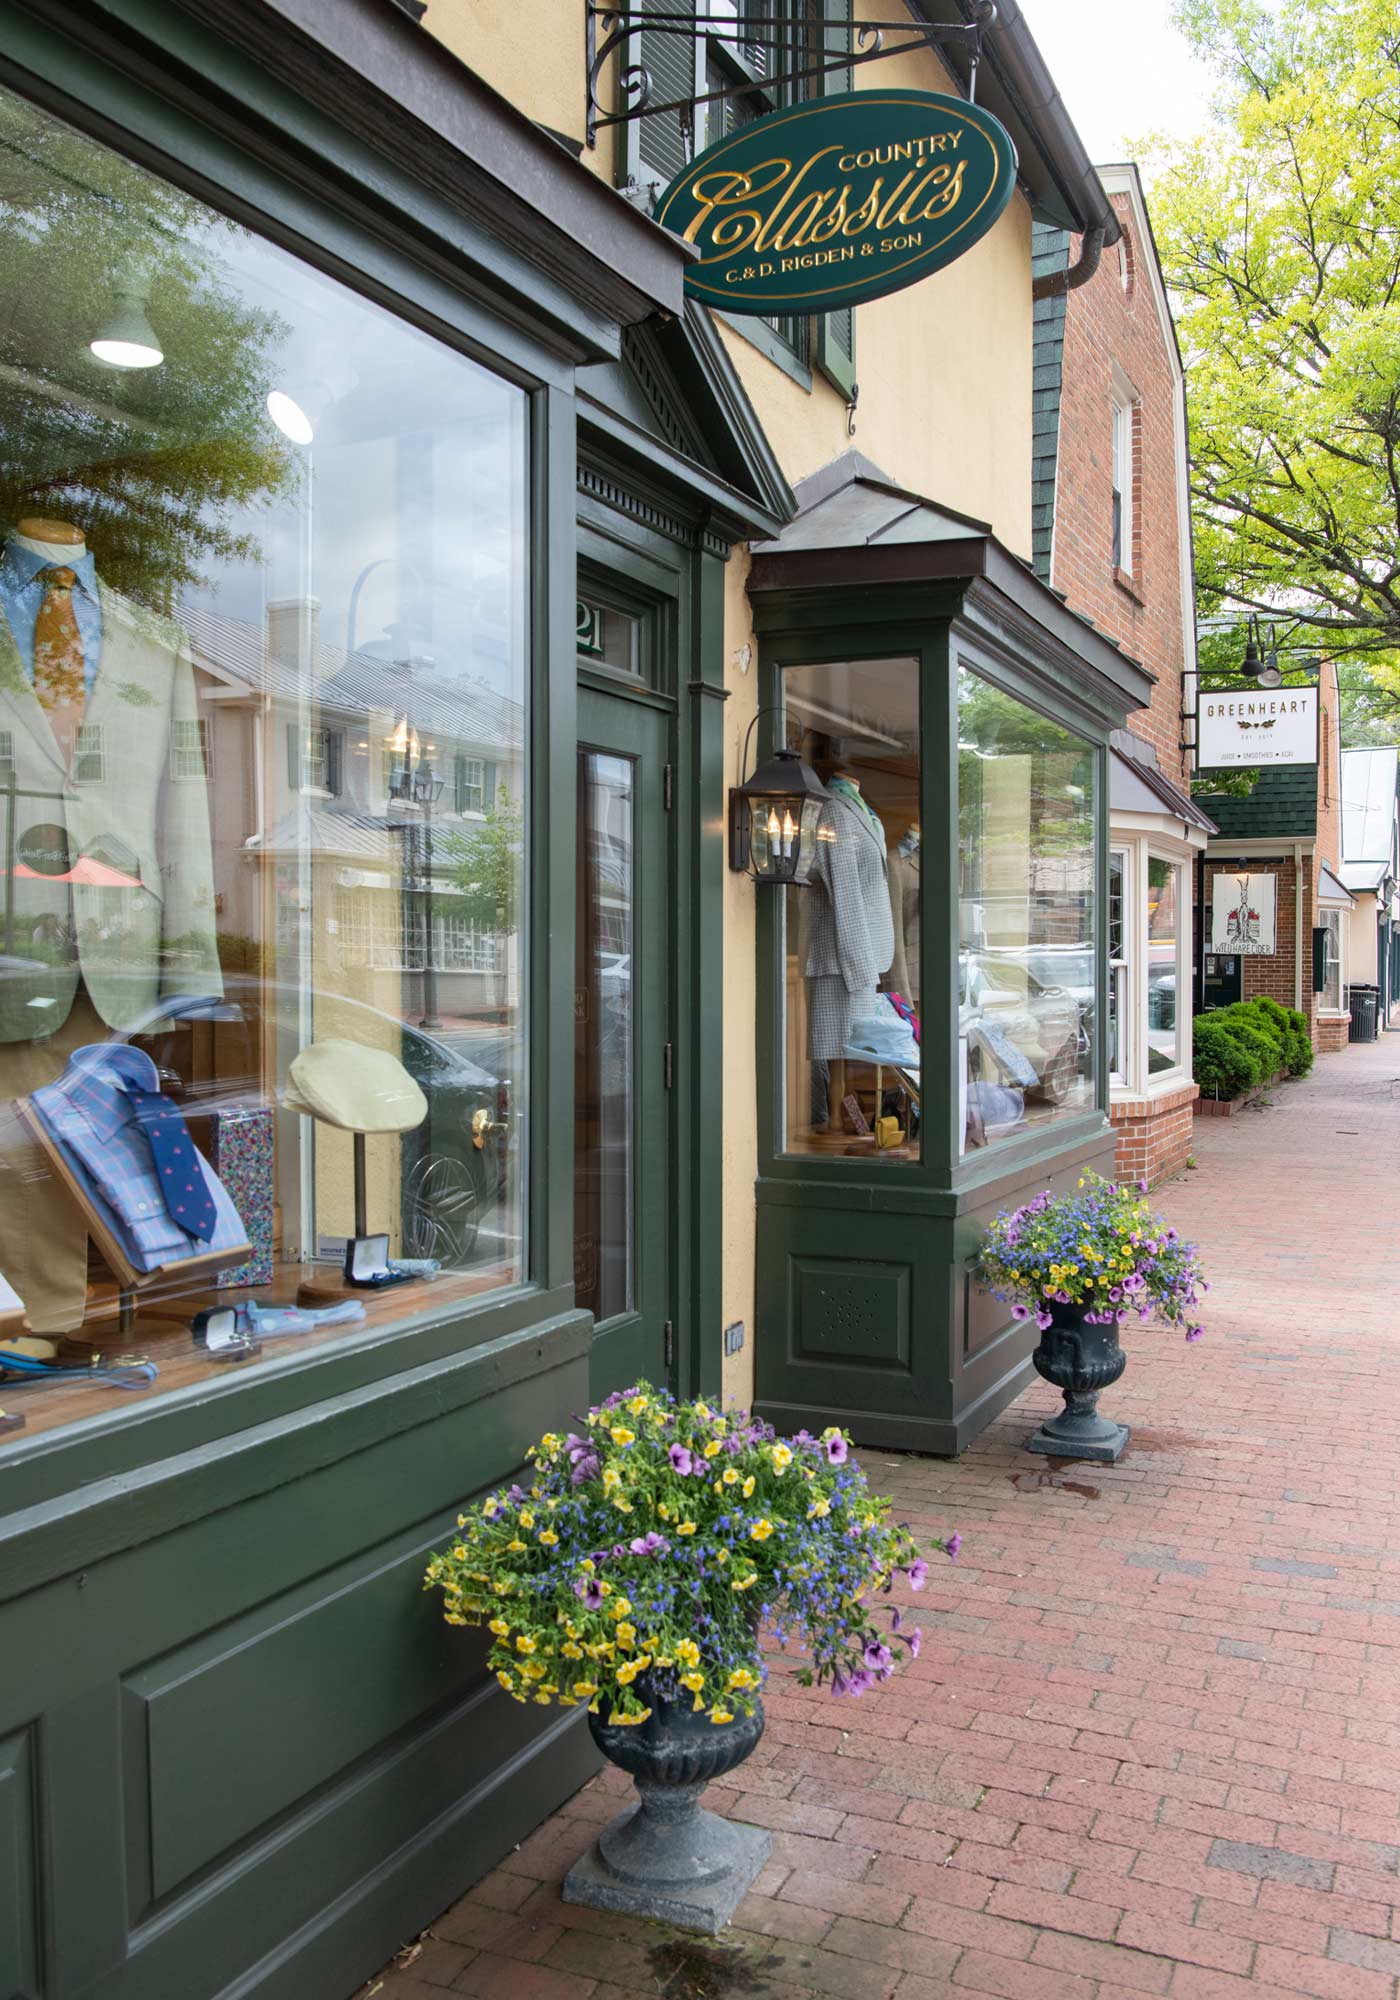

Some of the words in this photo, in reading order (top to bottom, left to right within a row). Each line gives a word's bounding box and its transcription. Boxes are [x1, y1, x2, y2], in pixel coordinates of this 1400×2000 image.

[838, 129, 964, 173] COUNTRY
[682, 144, 968, 264] Classics
[781, 246, 854, 273] RIGDEN
[880, 232, 922, 254] SON
[1207, 700, 1308, 718] GREENHEART
[1242, 751, 1273, 760] SMOOTHIES
[1215, 943, 1232, 954] WILD
[1232, 944, 1251, 955] HARE
[1251, 944, 1271, 955] CIDER
